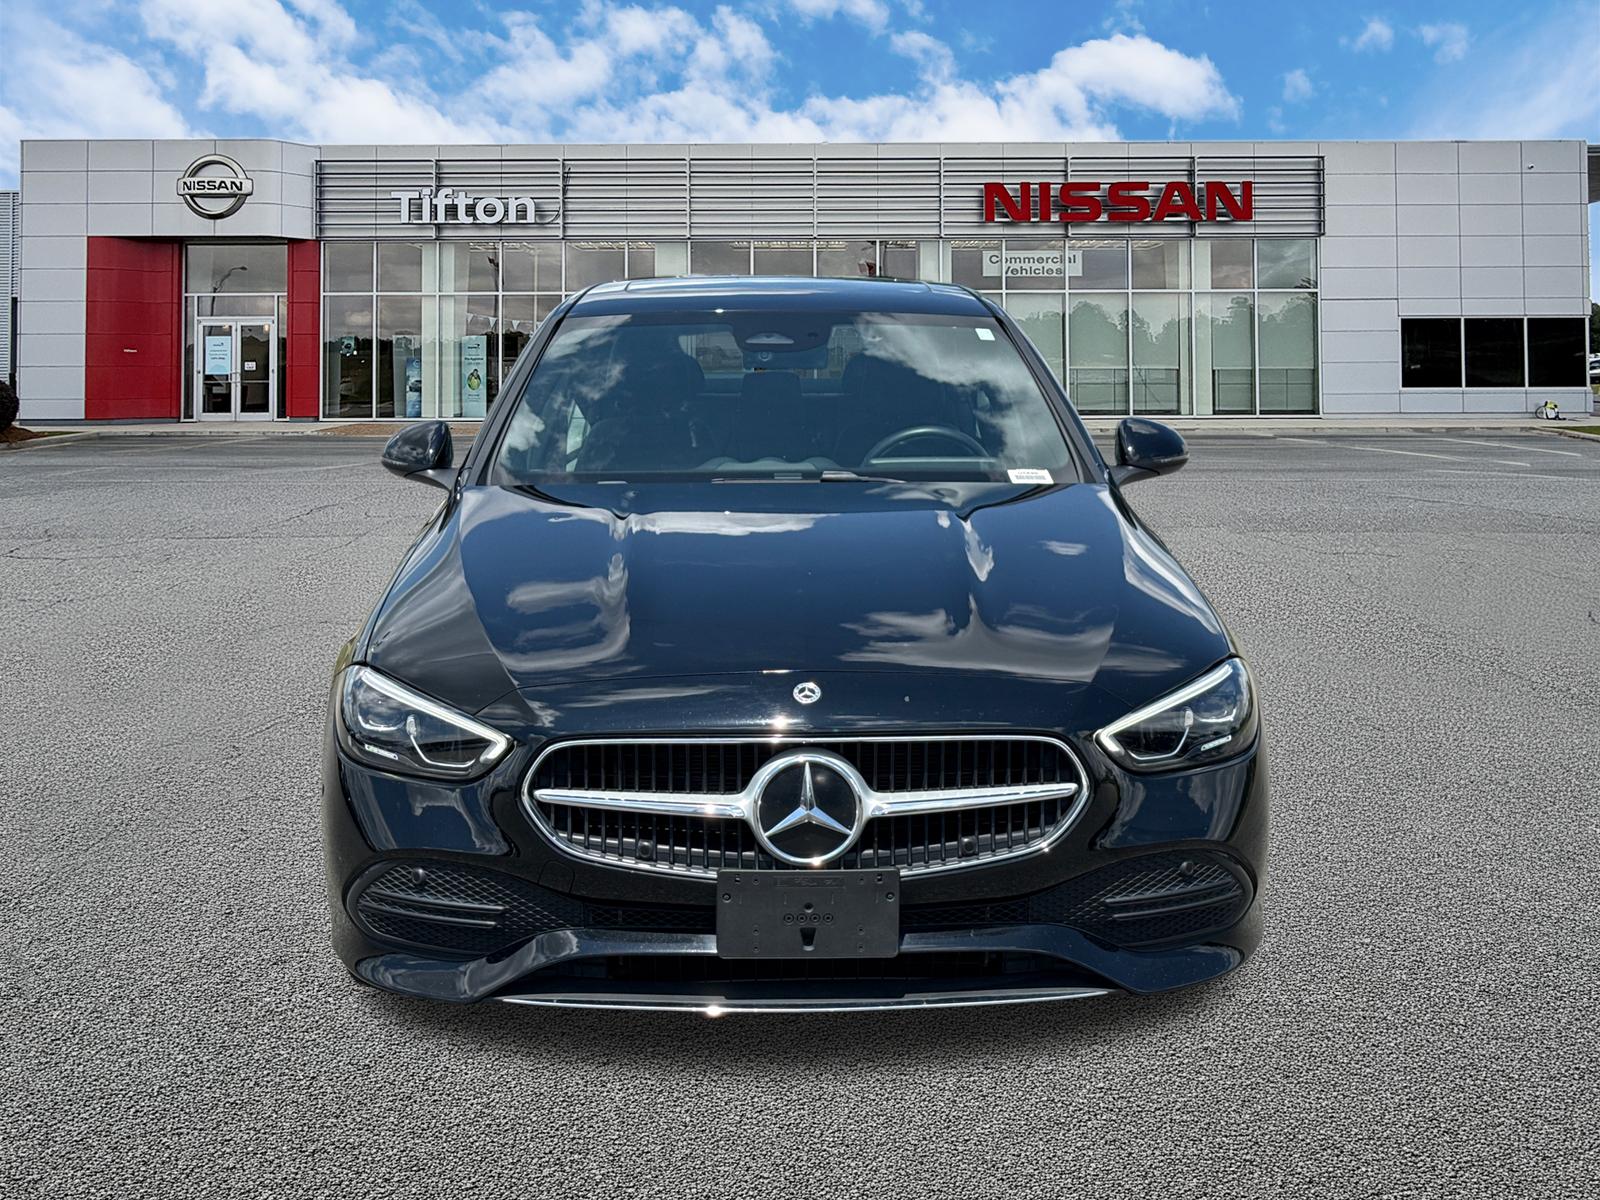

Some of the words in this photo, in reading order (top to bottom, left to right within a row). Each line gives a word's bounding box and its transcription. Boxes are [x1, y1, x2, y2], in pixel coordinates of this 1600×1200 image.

[182, 180, 243, 191] NISSAN
[391, 187, 536, 224] Tifton
[984, 181, 1254, 222] NISSAN
[1004, 265, 1063, 276] Vehicles
